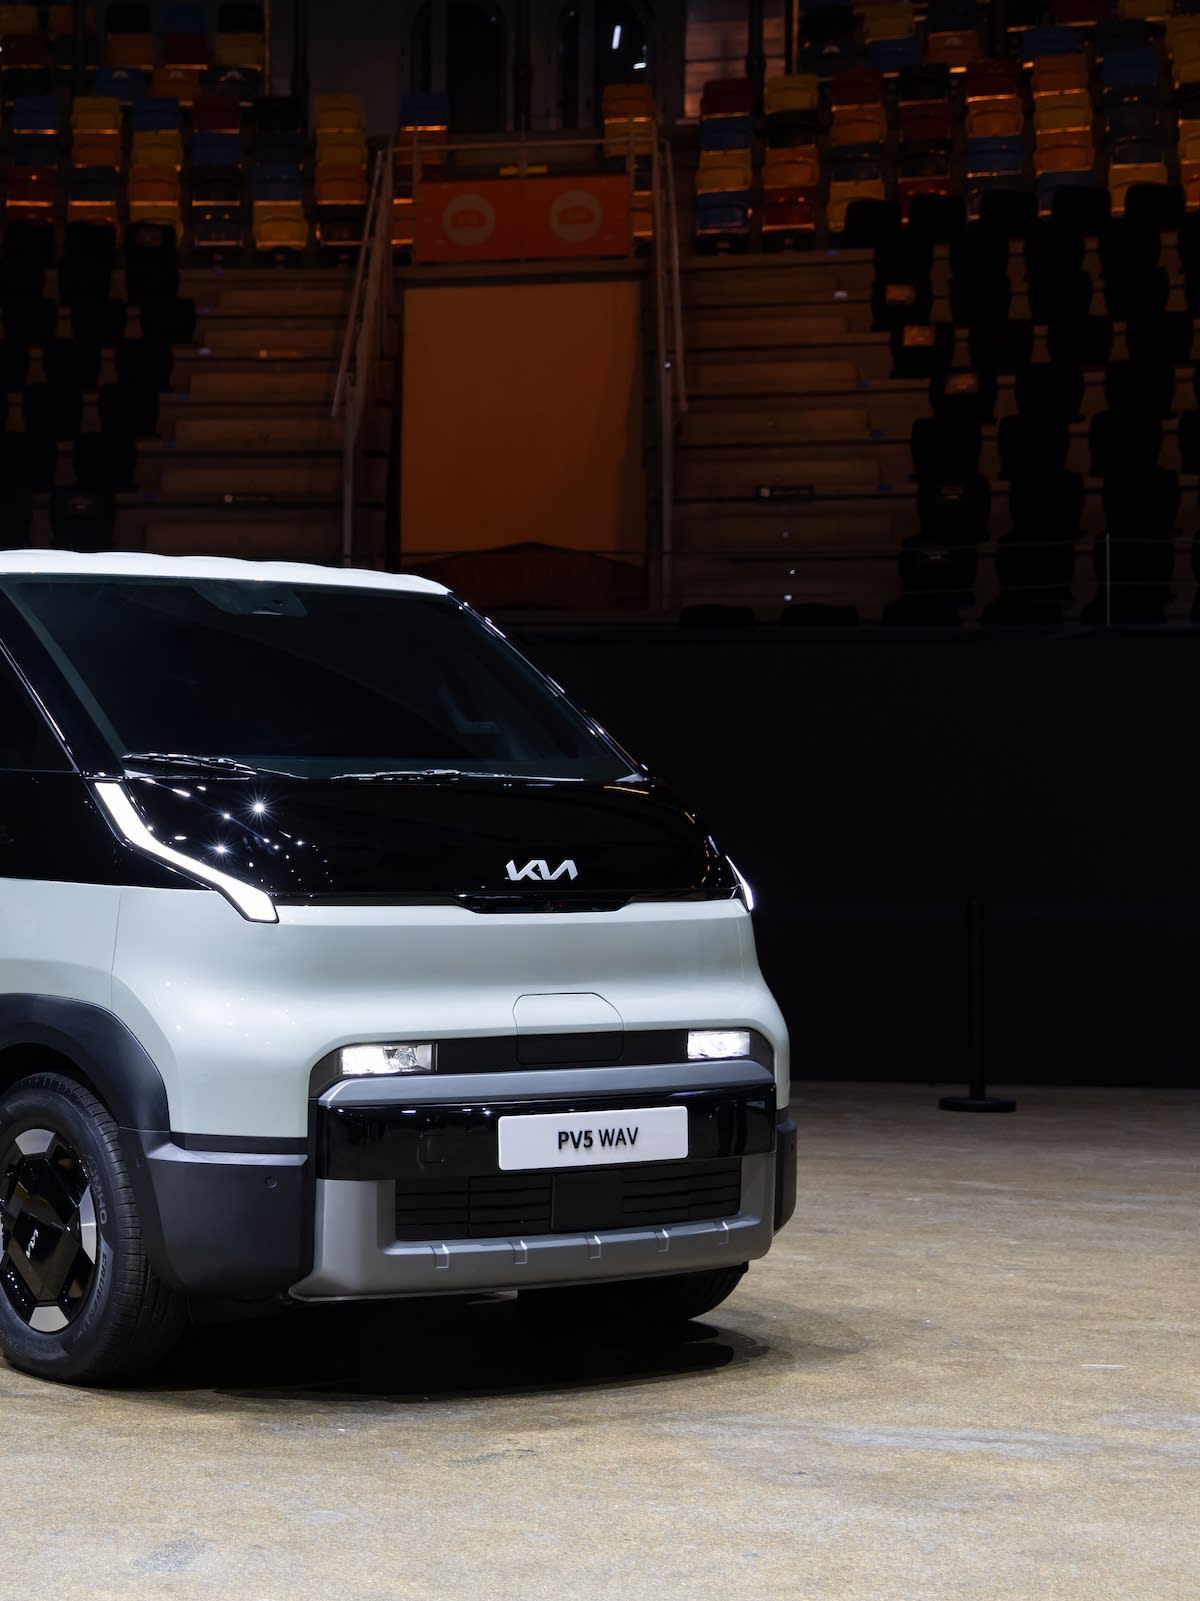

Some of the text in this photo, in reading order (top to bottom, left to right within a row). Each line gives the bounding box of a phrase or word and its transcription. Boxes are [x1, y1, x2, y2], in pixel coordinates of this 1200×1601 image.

[504, 859, 579, 881] KIA
[557, 1126, 639, 1150] PV5 WAV
